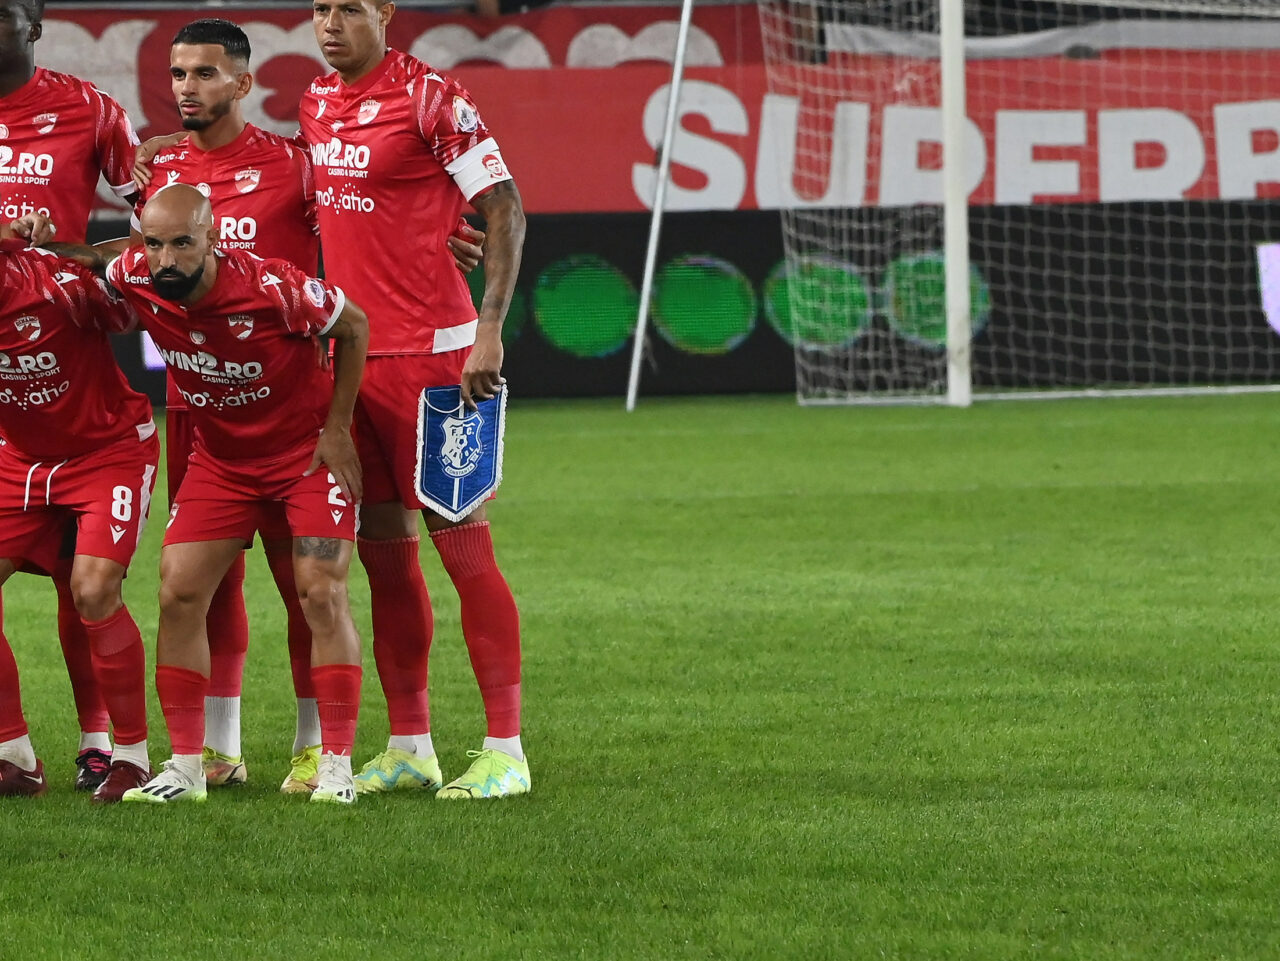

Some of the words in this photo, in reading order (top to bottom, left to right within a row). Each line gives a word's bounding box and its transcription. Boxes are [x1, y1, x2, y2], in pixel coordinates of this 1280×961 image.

[24, 177, 51, 185] SPORT
[229, 242, 256, 250] SPORT
[159, 348, 263, 380] WIN2.RO
[35, 366, 61, 379] SPORT
[201, 374, 229, 384] CASINO
[111, 485, 133, 522] 8
